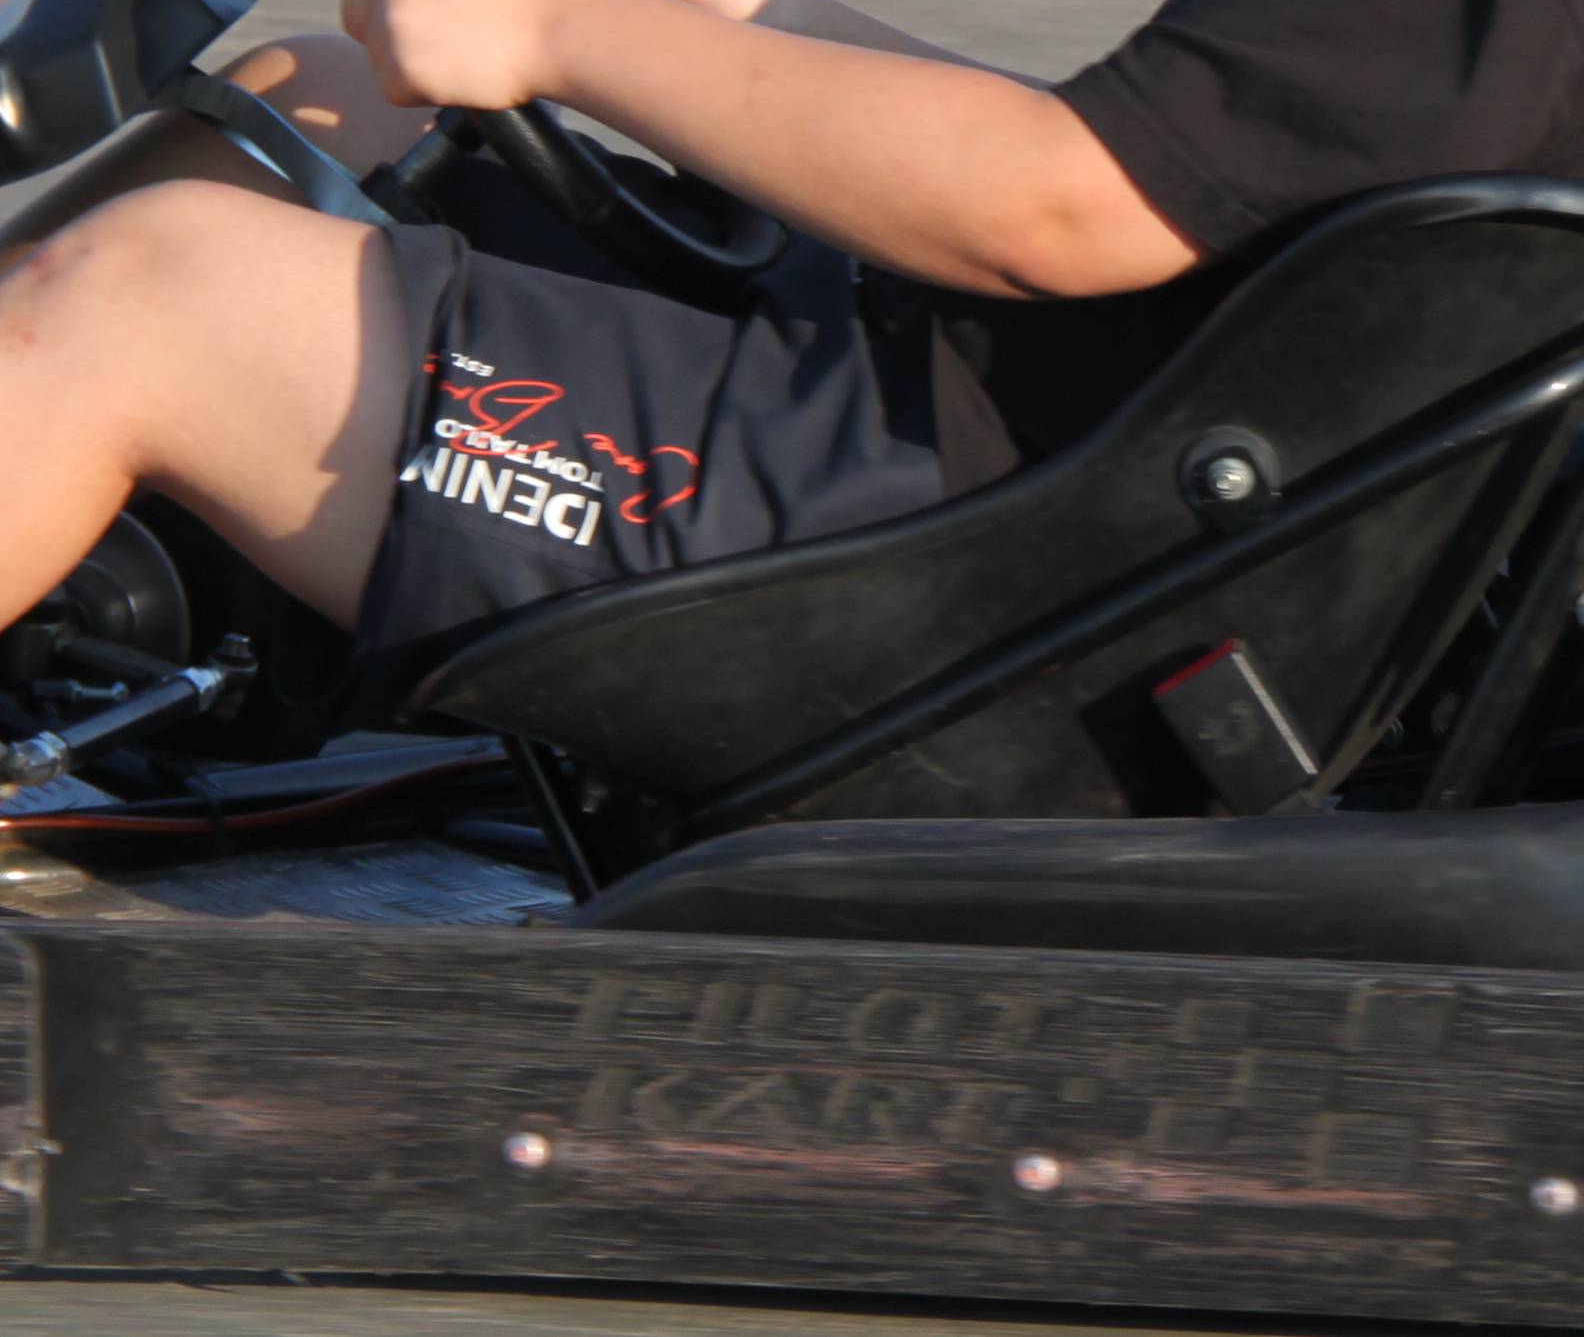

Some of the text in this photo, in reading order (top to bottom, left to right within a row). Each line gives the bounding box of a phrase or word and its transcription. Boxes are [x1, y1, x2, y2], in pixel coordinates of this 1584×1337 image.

[400, 444, 602, 546] DENIM
[435, 419, 604, 491] TOM TAILO
